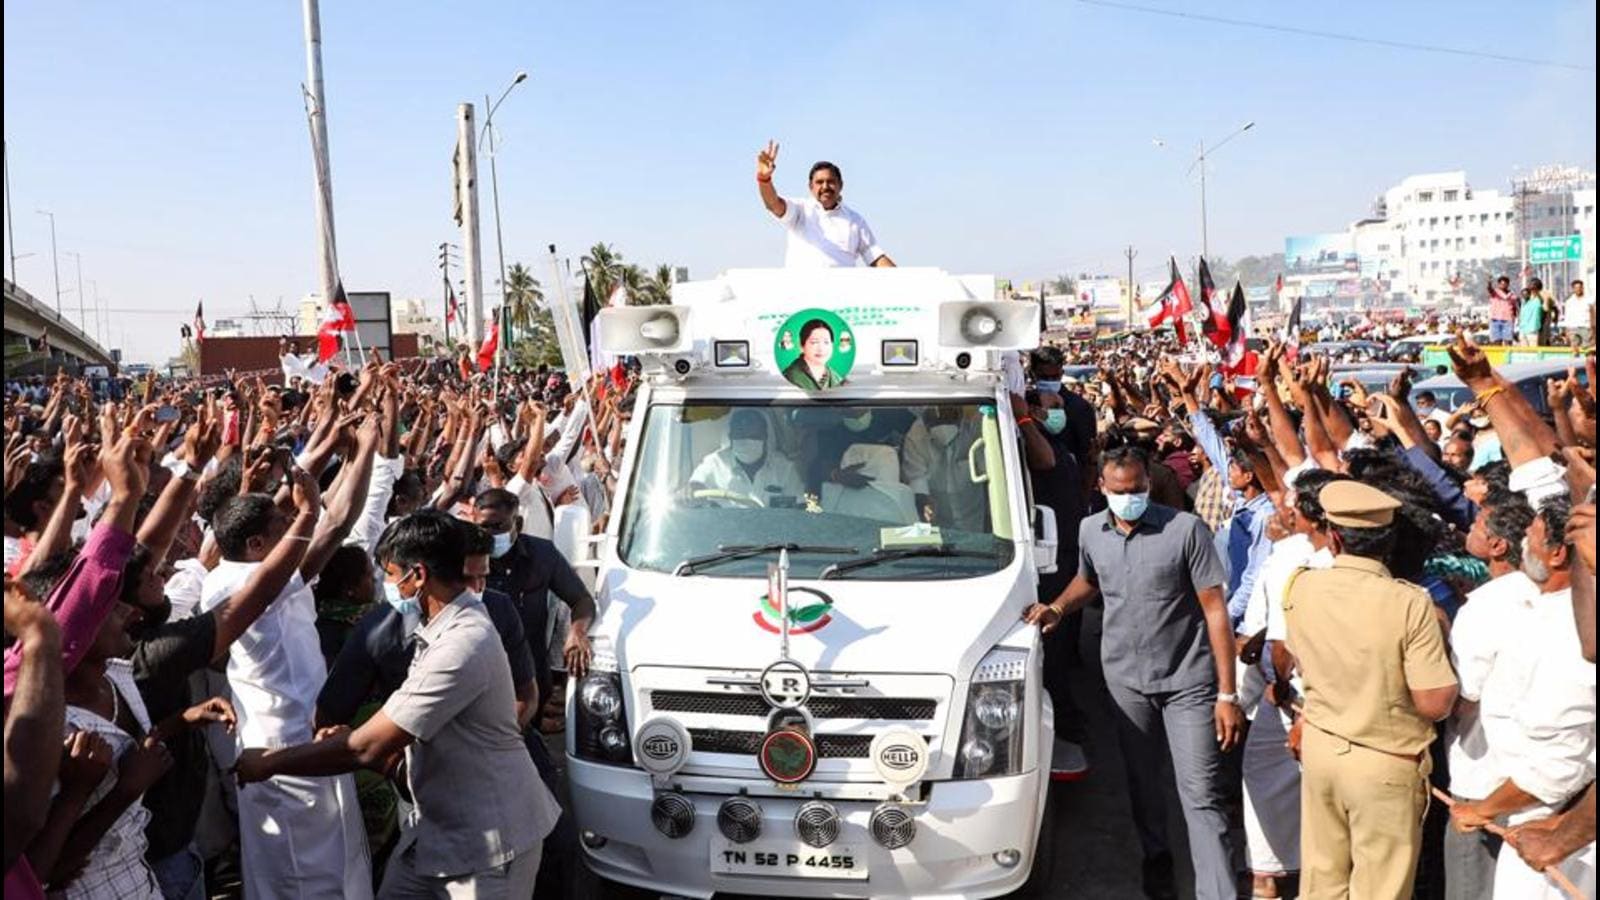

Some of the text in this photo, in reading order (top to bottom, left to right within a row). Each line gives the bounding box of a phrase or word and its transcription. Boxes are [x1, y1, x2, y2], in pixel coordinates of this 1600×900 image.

[645, 742, 678, 753] HELLA
[883, 751, 918, 762] HELLA
[723, 851, 854, 868] TN 52 P 4455
